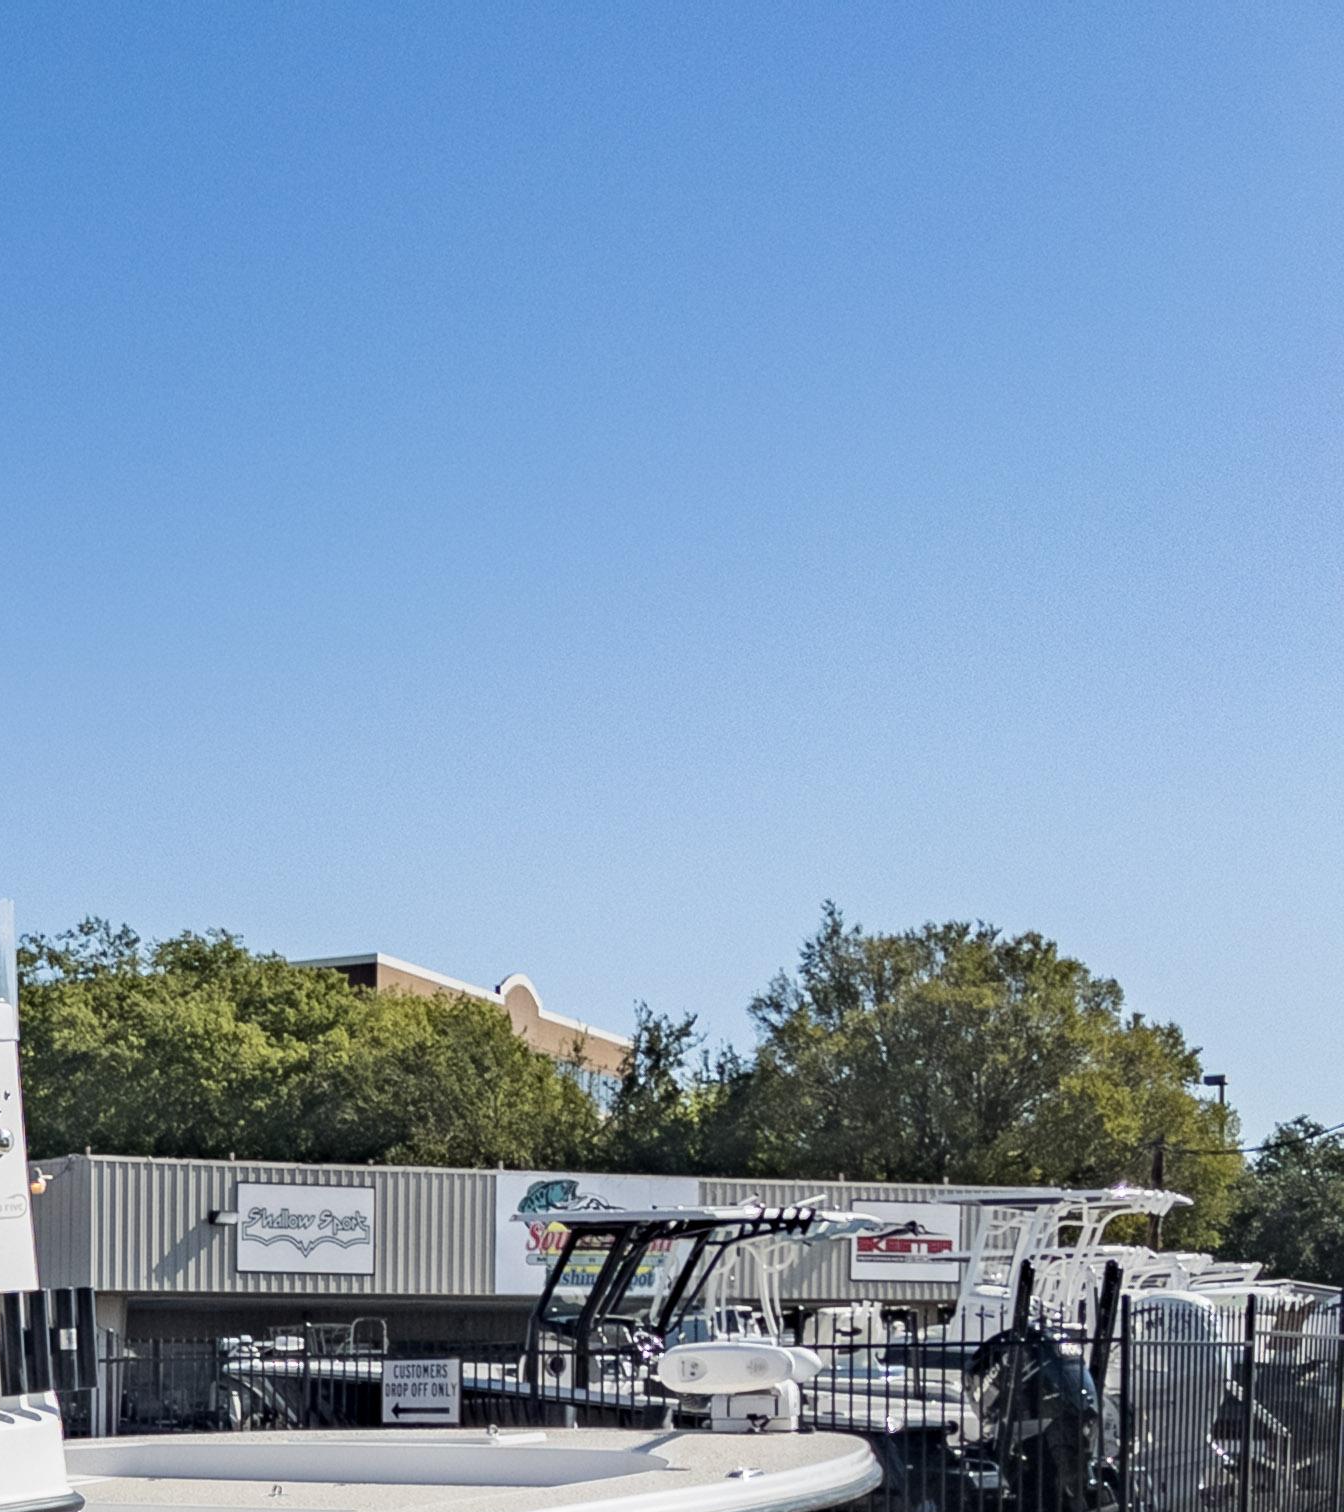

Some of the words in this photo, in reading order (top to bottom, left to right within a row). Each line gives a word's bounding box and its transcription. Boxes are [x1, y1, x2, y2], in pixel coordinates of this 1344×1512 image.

[247, 1206, 316, 1230] Shallow
[318, 1208, 368, 1236] Sport
[393, 1364, 449, 1379] CUSTOMERS
[385, 1382, 409, 1398] DROP
[411, 1382, 429, 1398] OFF
[431, 1382, 458, 1398] ONLY
